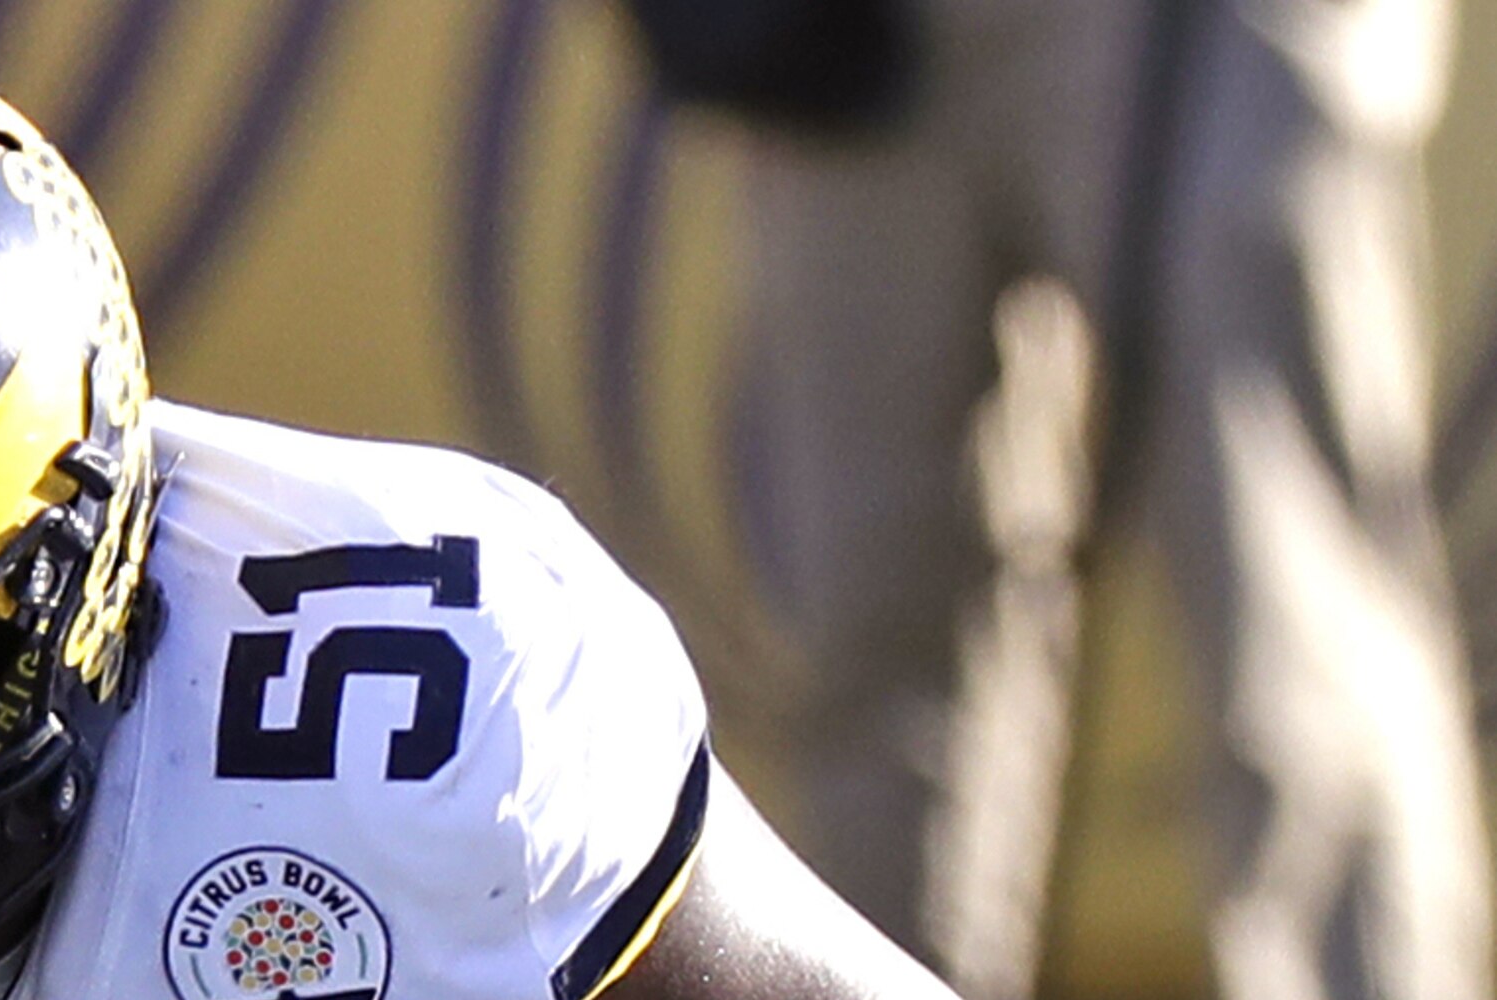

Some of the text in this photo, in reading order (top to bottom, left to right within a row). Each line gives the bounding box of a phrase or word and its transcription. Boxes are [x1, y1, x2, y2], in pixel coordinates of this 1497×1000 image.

[215, 533, 480, 781] 51
[179, 859, 360, 949] CITRUS BOWL
